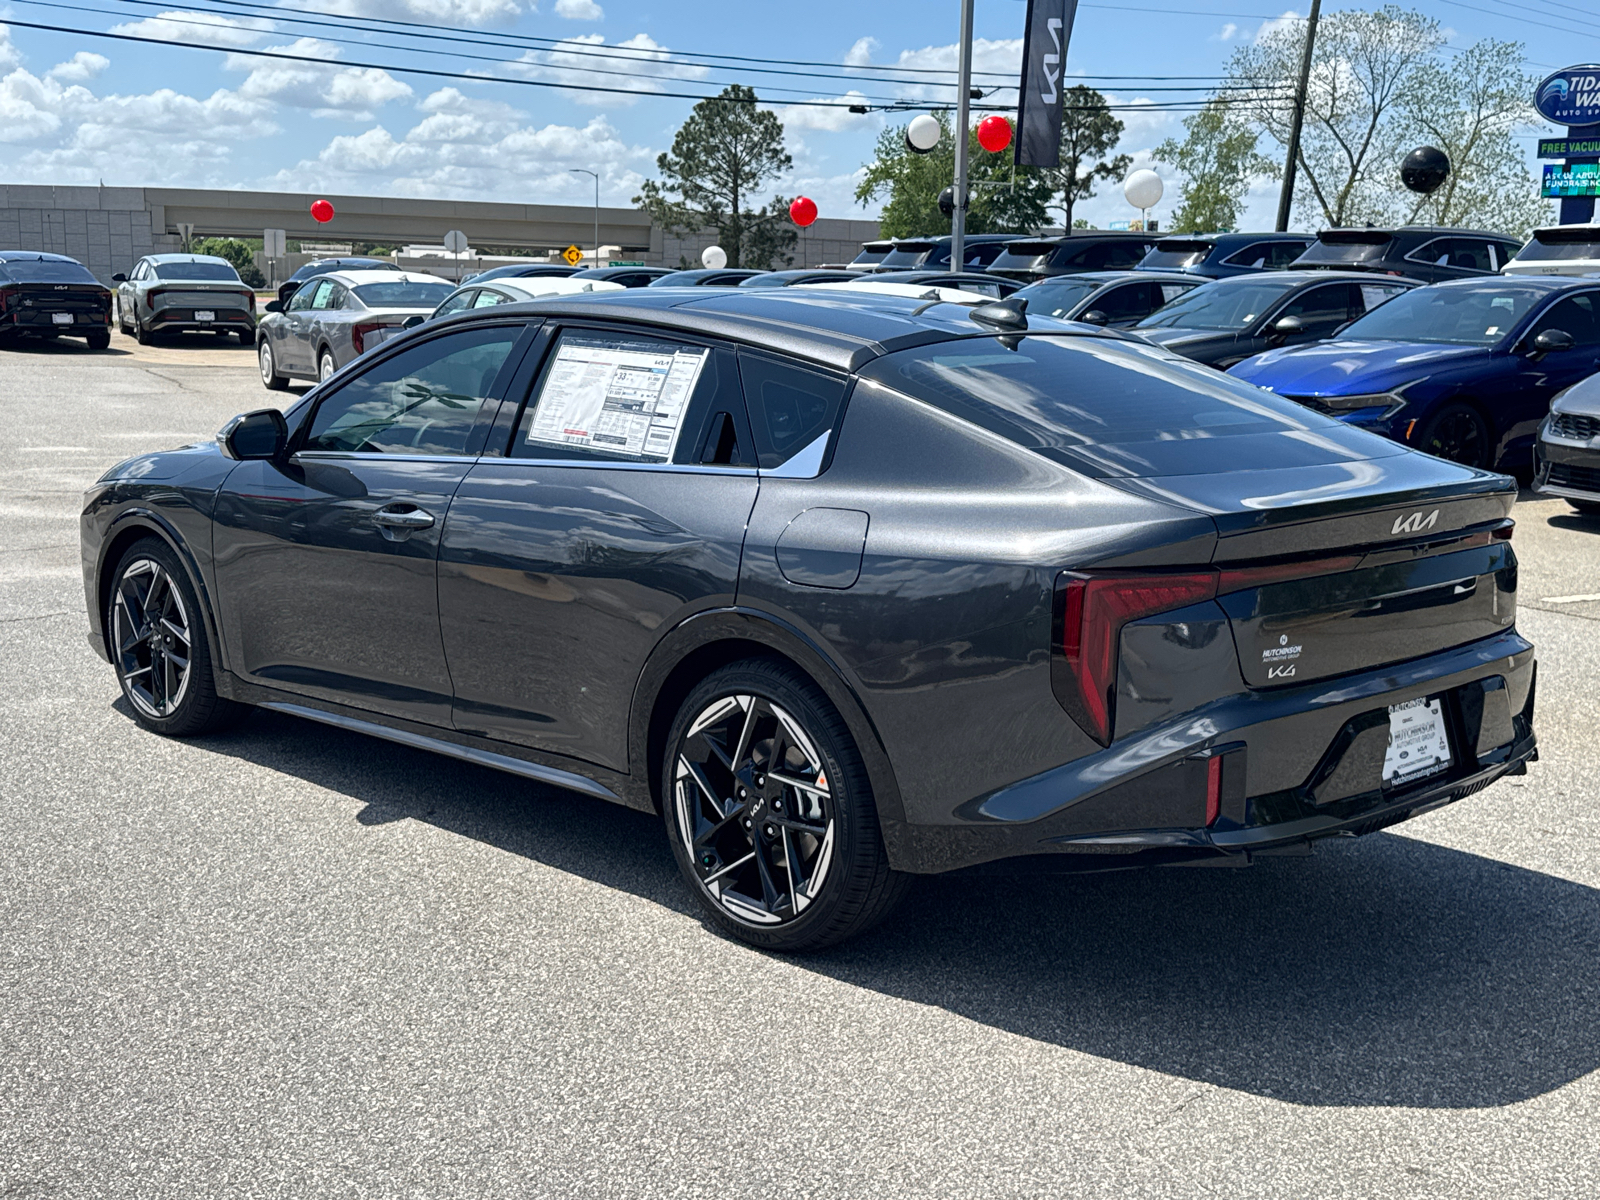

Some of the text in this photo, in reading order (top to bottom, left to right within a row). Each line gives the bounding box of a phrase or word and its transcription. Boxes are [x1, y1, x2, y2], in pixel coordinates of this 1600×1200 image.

[1541, 142, 1567, 154] FREE
[1391, 508, 1440, 535] KIA
[1262, 645, 1303, 658] HUTCHINSON
[1267, 664, 1296, 679] K4
